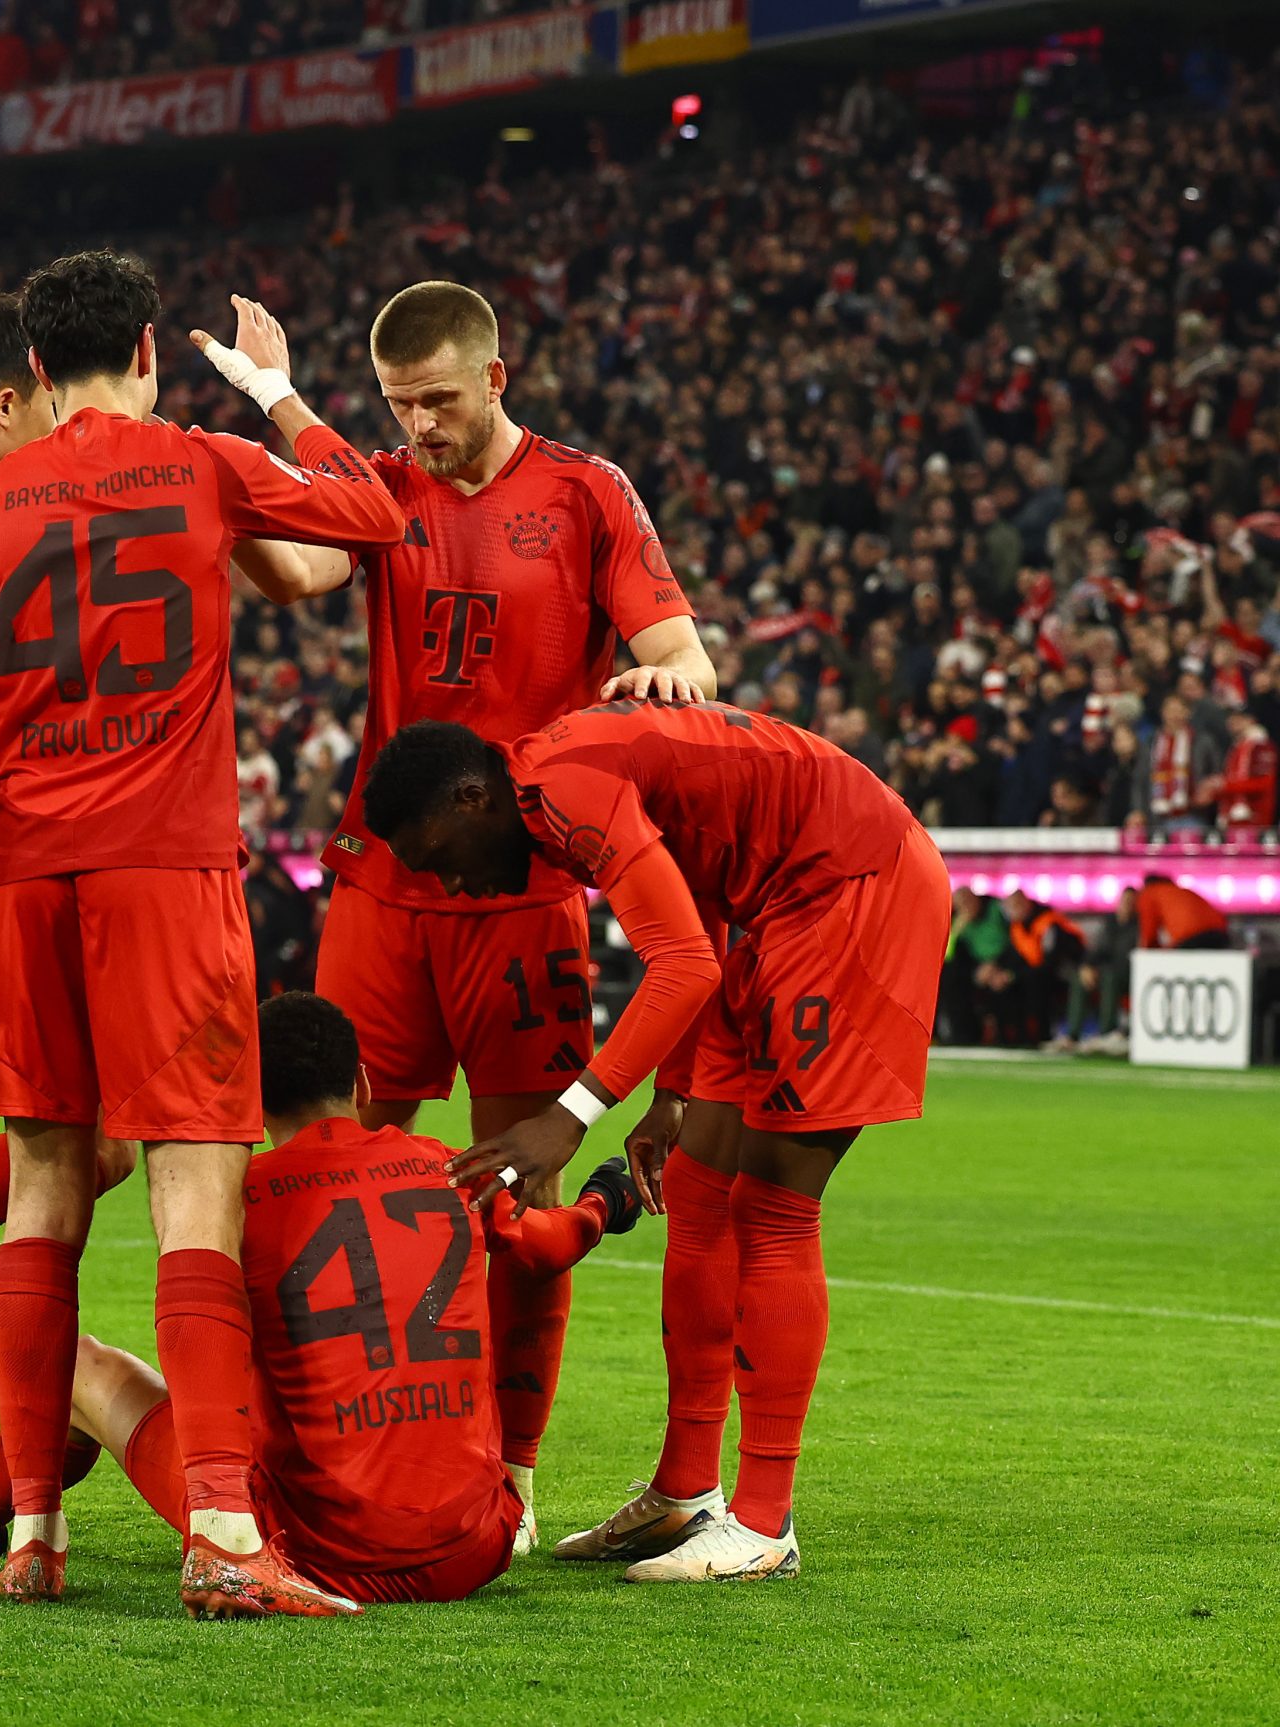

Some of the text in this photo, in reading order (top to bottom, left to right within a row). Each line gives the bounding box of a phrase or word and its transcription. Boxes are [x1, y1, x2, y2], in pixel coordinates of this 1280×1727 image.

[32, 68, 247, 153] Zillertal
[5, 481, 85, 511] BAYERN
[95, 463, 195, 498] MÜNCHEN
[422, 586, 502, 689] T
[502, 947, 592, 1032] 15
[747, 995, 830, 1071] 19
[269, 1168, 360, 1198] BAYERN
[367, 1157, 443, 1182] MÜNCHE
[276, 1187, 482, 1372] 42
[332, 1379, 475, 1435] MUSIALA
